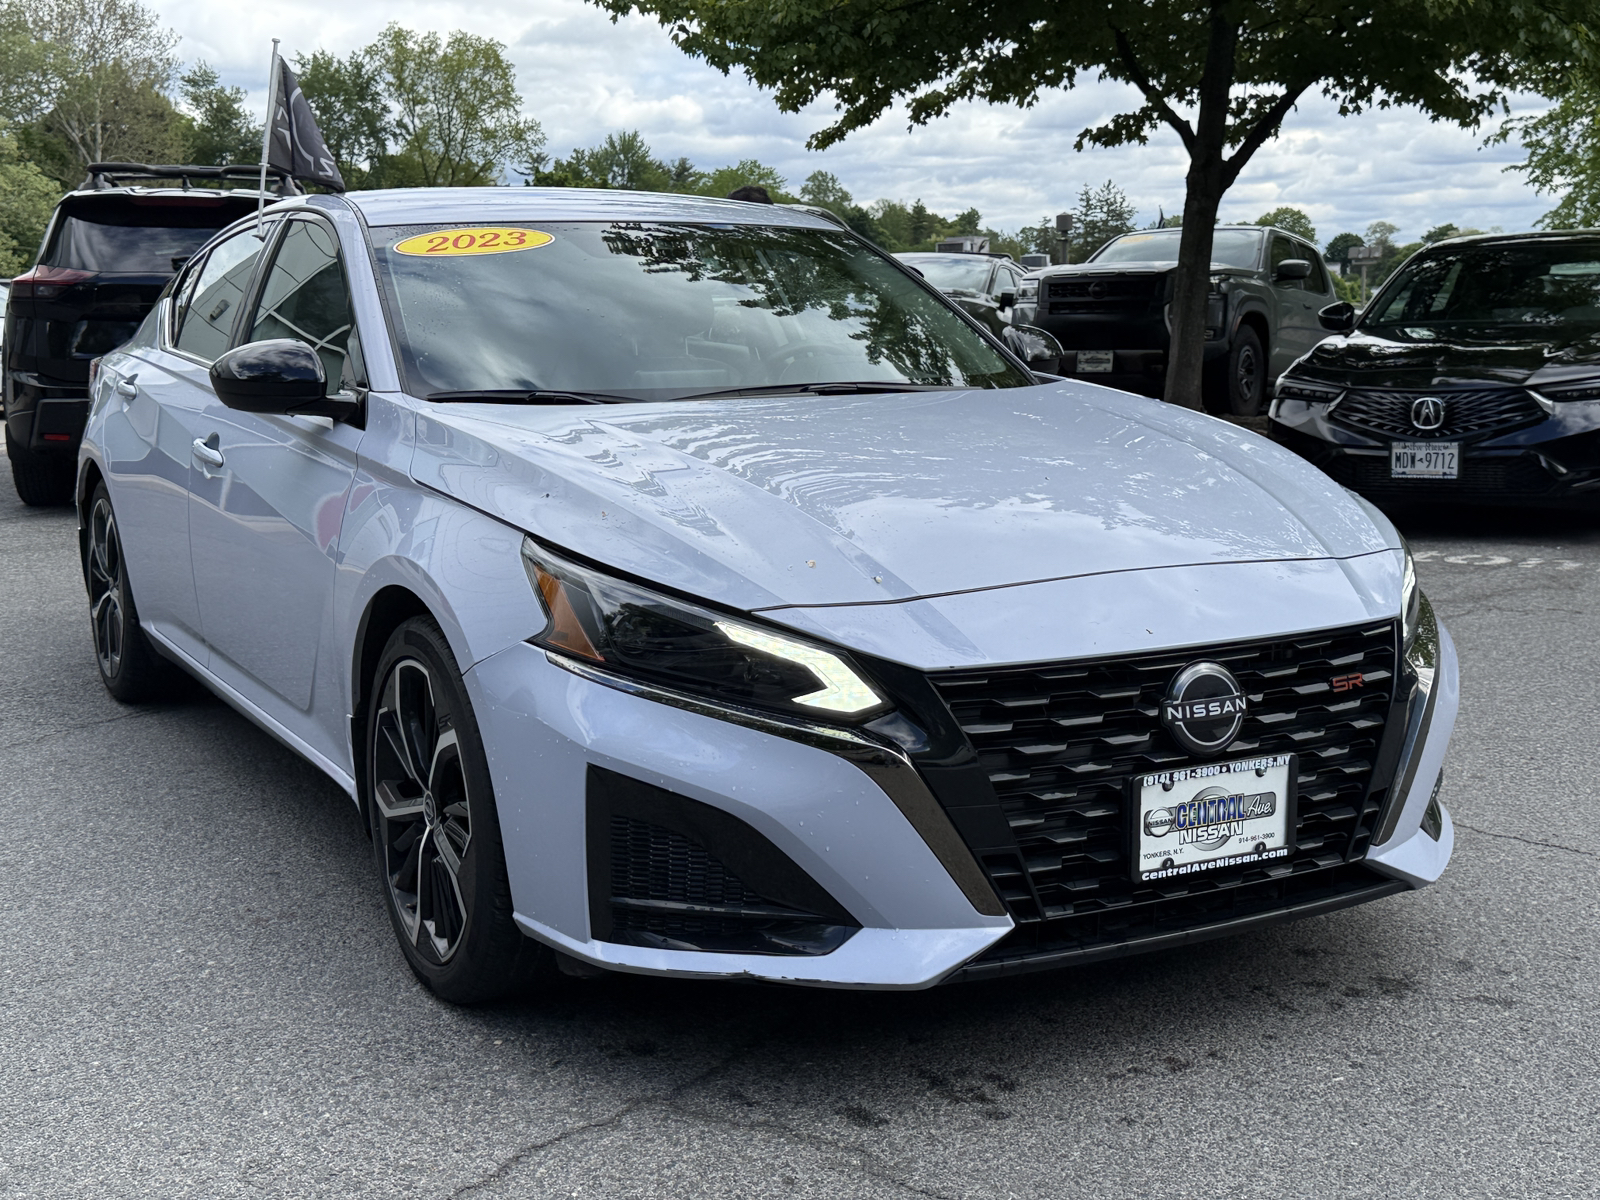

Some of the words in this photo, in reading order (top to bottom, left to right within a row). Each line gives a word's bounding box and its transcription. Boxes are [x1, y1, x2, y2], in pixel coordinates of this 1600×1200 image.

[426, 231, 527, 253] 2023
[1332, 672, 1363, 693] SR
[1167, 696, 1247, 720] NISSAN
[1173, 766, 1220, 782] 961-3900
[1147, 817, 1173, 827] NISSAN
[1176, 793, 1246, 830] CENTRAL
[1247, 796, 1273, 816] Ave.
[1178, 820, 1244, 845] NISSAN
